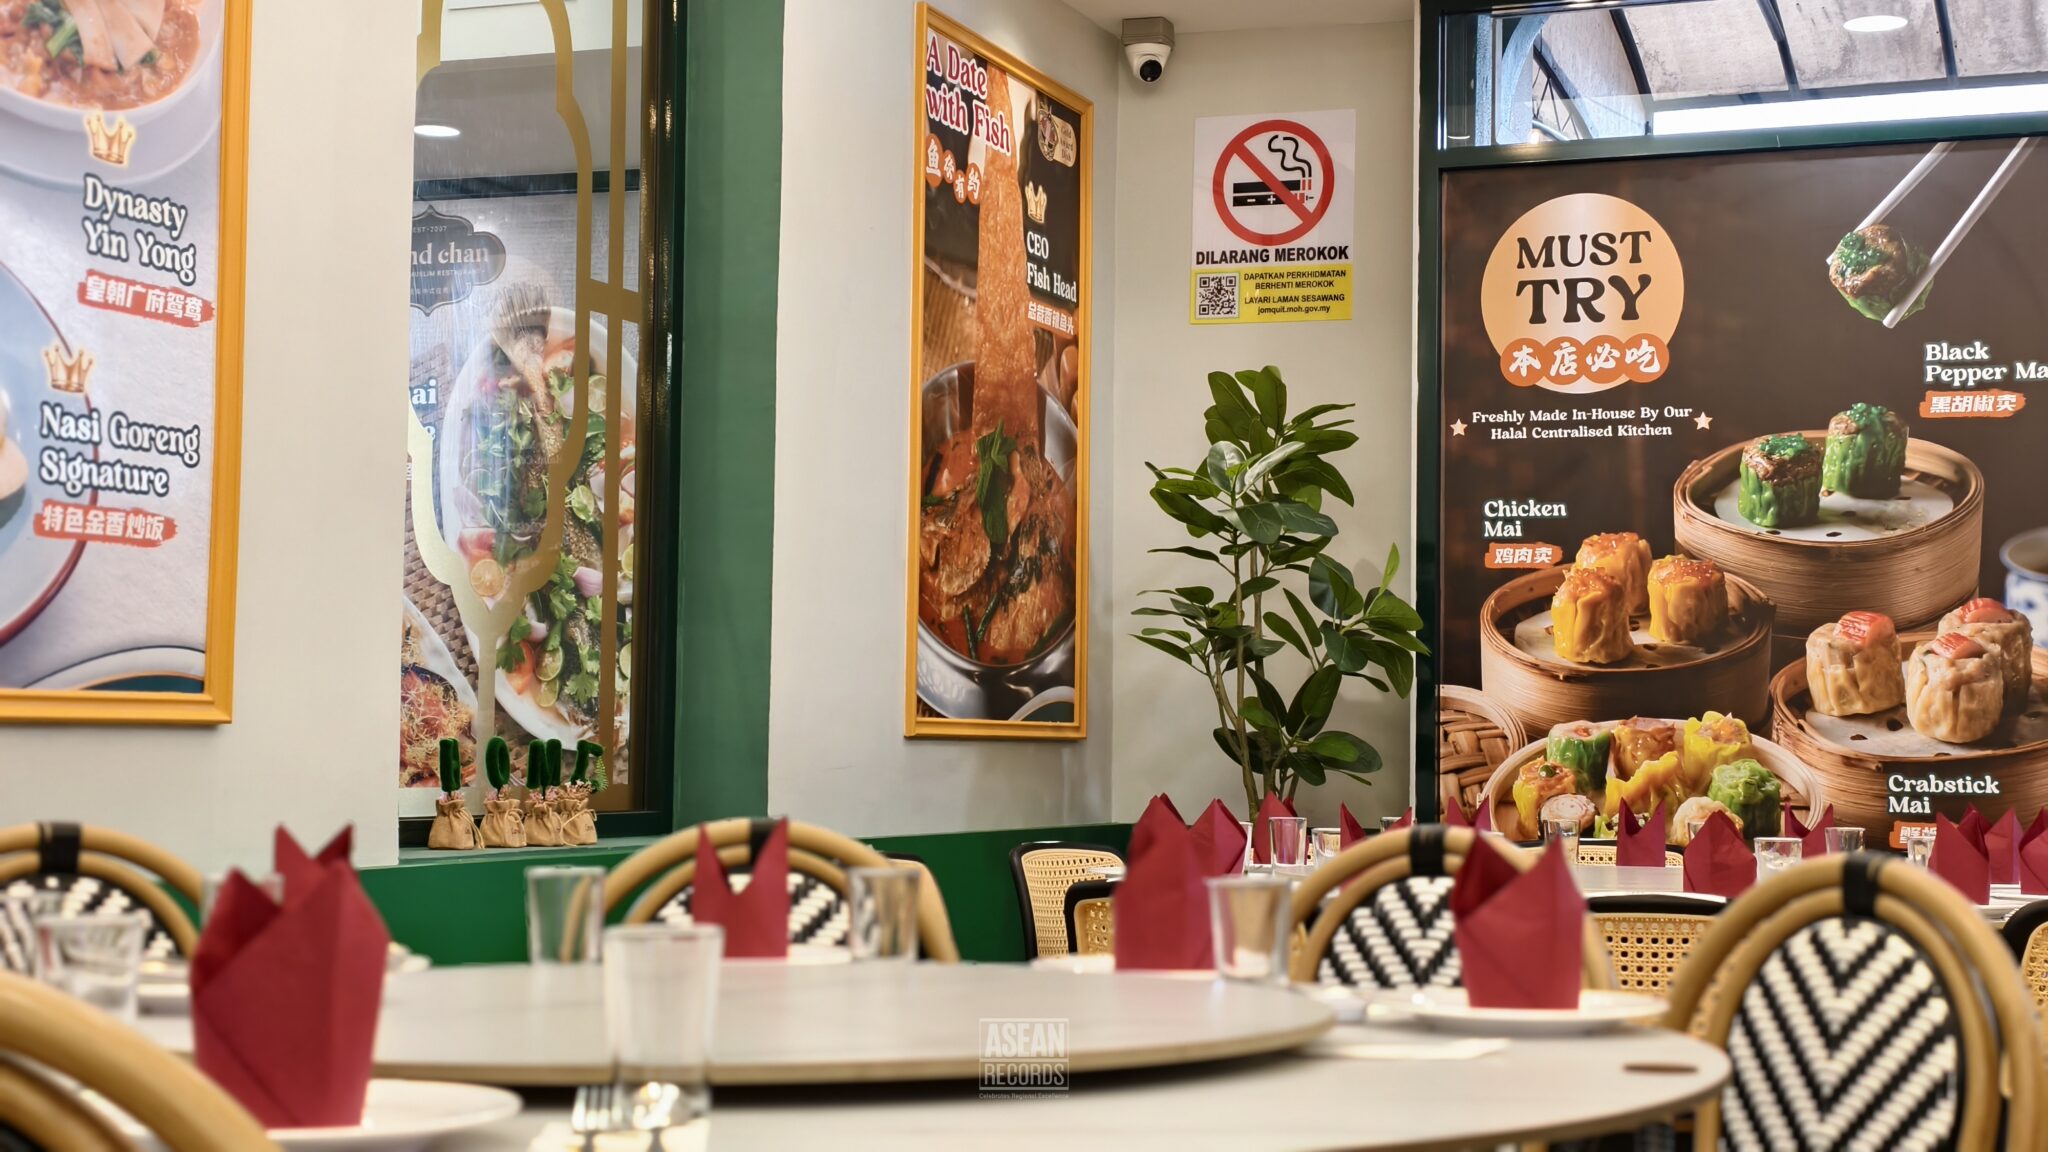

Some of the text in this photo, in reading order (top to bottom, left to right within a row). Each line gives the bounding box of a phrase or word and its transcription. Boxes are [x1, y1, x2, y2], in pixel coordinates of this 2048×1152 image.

[927, 35, 987, 97] A Date
[926, 85, 1011, 153] with Fish
[84, 176, 187, 237] Dynasty
[84, 221, 195, 283] Yin Yong
[438, 241, 488, 264] chan
[1026, 231, 1049, 259] CEO
[1195, 246, 1349, 265] DILARANG MEROKOK
[1516, 230, 1652, 269] MUST
[1027, 262, 1077, 302] Fish Head
[1243, 270, 1346, 280] DAPATKAN PERKHIDMATAN
[1255, 280, 1335, 290] BERHENTI MEROKOK
[85, 275, 203, 321] 皇朝广府鸳鸯
[1244, 293, 1345, 304] LAYARI LAMAN SESAWANG
[1515, 273, 1652, 324] TRY
[1258, 305, 1331, 315] jomquit.moh.gov.my
[1508, 339, 1661, 377] 本店必吃
[1925, 341, 1989, 361] Black
[1925, 361, 2048, 387] Pepper Ma
[1472, 405, 1692, 425] Freshly Made In-House By Our
[1930, 394, 2017, 414] 黑胡椒卖
[41, 406, 200, 465] Nasi Goreng
[1491, 424, 1672, 440] Halal Centralised Kitchen
[40, 449, 169, 495] Signature
[1484, 499, 1567, 517] Chicken
[41, 504, 165, 540] 特色金香炒饭
[1484, 520, 1522, 537] Mai
[1494, 547, 1553, 564] 鸡肉卖
[1888, 774, 2000, 794] Crabstick
[1888, 796, 1931, 813] Mai
